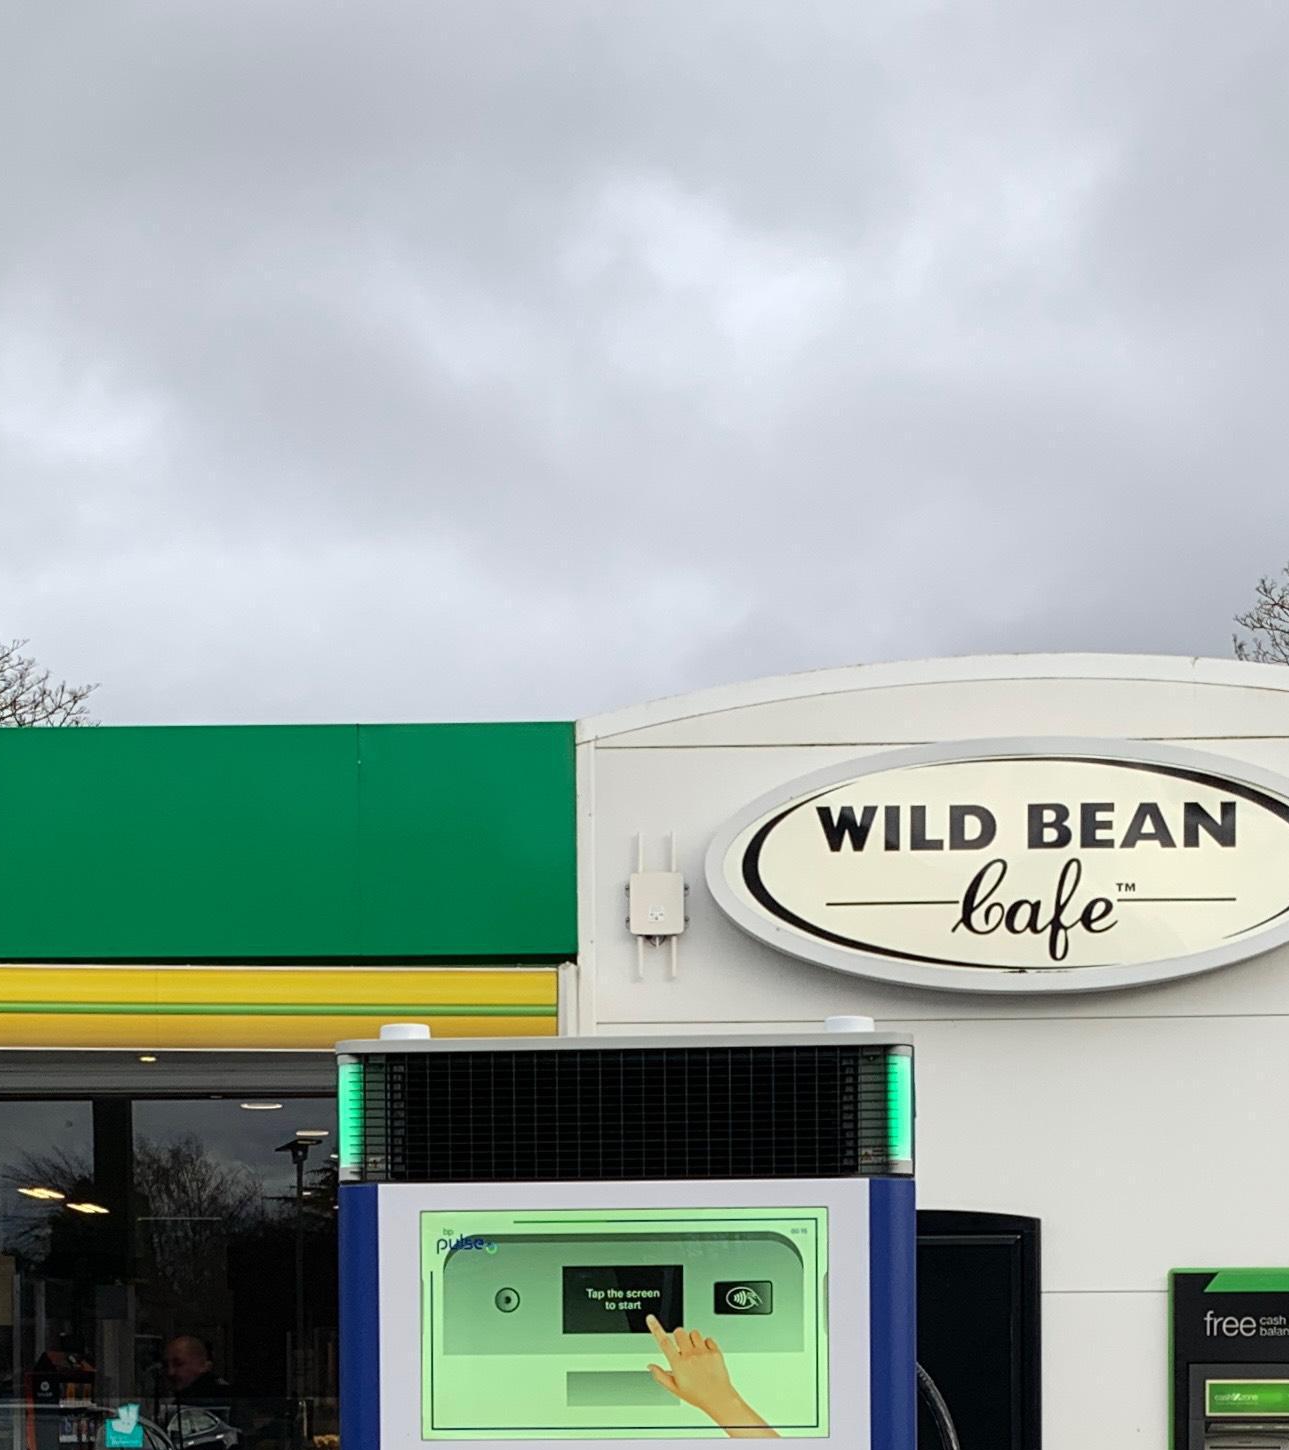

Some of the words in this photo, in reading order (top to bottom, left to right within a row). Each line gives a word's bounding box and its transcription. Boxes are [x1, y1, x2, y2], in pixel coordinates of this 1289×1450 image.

[816, 804, 997, 852] WILD
[1027, 801, 1237, 850] BEAN
[952, 858, 1118, 961] Cafe
[436, 1233, 485, 1254] pulse
[586, 1288, 605, 1300] Tap
[607, 1288, 624, 1298] the
[626, 1289, 661, 1298] screen
[605, 1301, 616, 1310] to
[618, 1301, 642, 1310] start
[1204, 1310, 1257, 1337] free
[1259, 1314, 1287, 1326] cash
